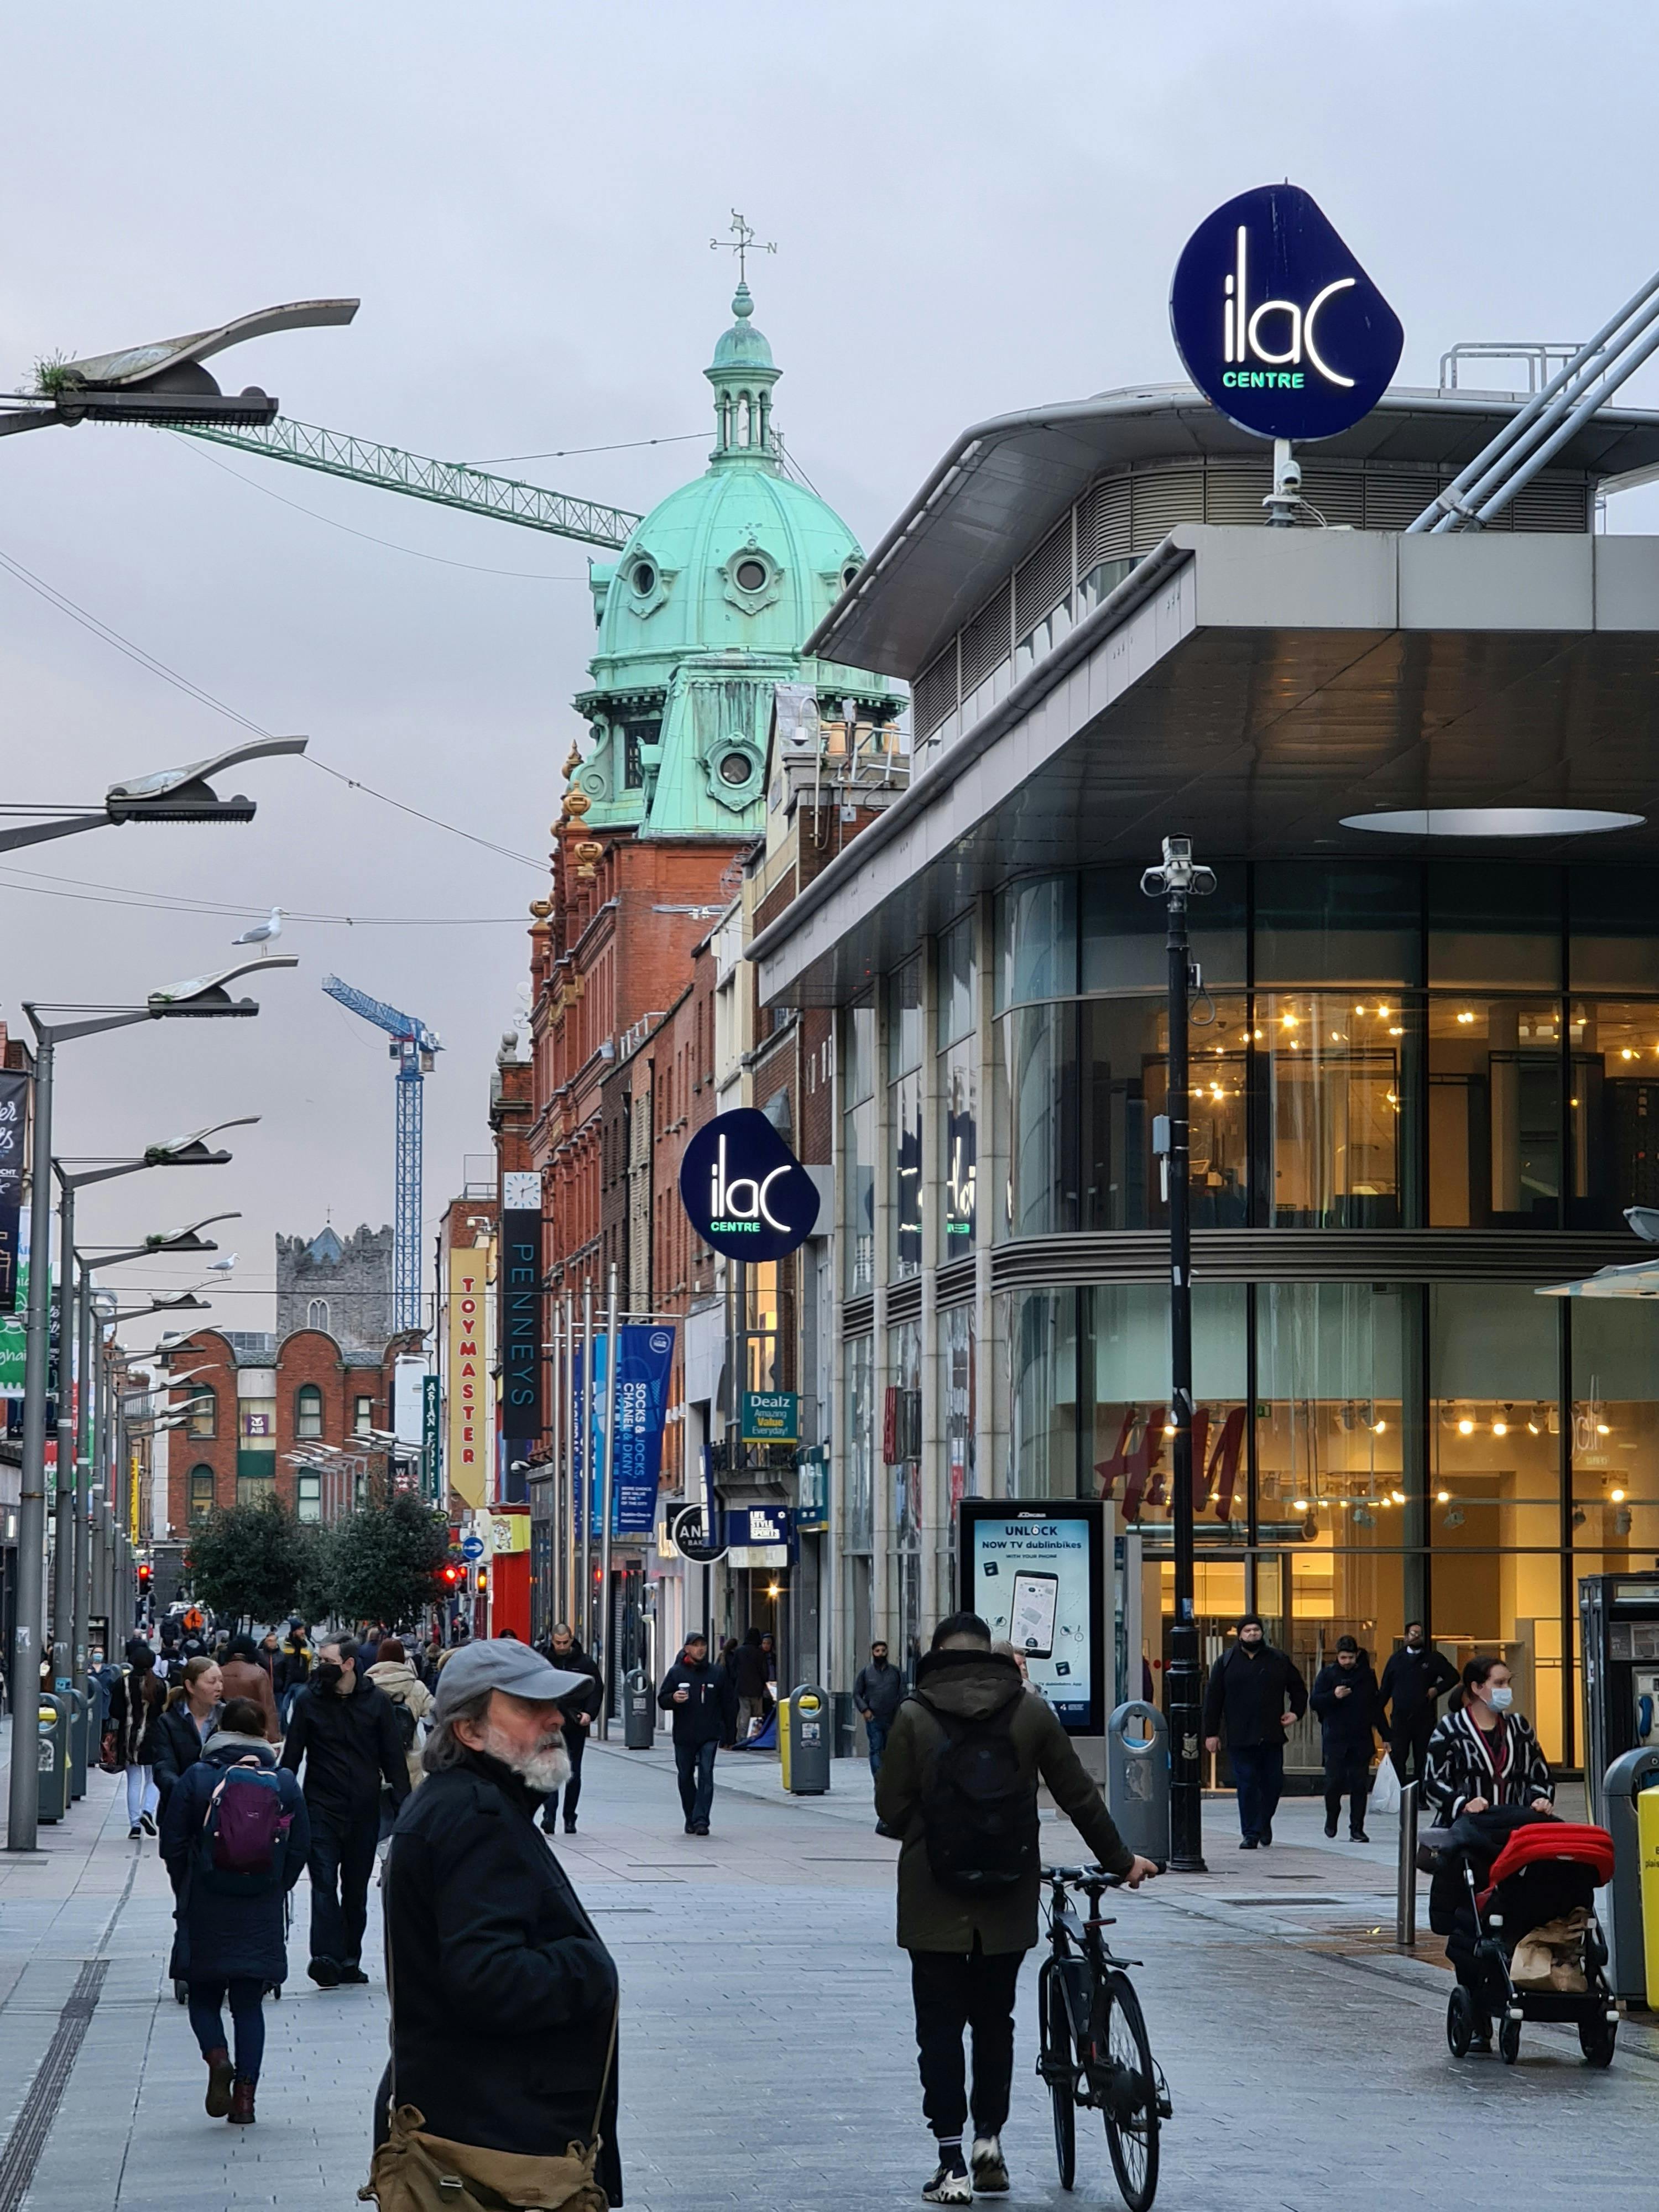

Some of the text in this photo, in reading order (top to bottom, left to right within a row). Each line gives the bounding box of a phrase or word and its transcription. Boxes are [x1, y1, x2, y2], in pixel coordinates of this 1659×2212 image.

[1224, 225, 1355, 387] ilac
[1223, 372, 1305, 389] CENTRE
[712, 1134, 791, 1232] ilac
[711, 1222, 761, 1232] CENTRE
[511, 1244, 534, 1405] PENNEYS
[459, 1276, 477, 1465] TOYMASTER
[426, 1383, 436, 1426] ASIAN
[623, 1383, 634, 1429] CHANEL
[635, 1383, 646, 1423] SOCKS
[750, 1395, 790, 1407] Dealz
[754, 1409, 787, 1419] Amazing
[757, 1417, 784, 1427] Value
[635, 1425, 646, 1433] &
[752, 1426, 788, 1436] Everyday!
[622, 1444, 633, 1477] DKNY
[750, 1520, 774, 1528] STYLE
[1005, 1524, 1058, 1536] UNLOCK
[750, 1529, 780, 1539] SPORTS
[982, 1541, 1082, 1549] NOW TV dublinbikes
